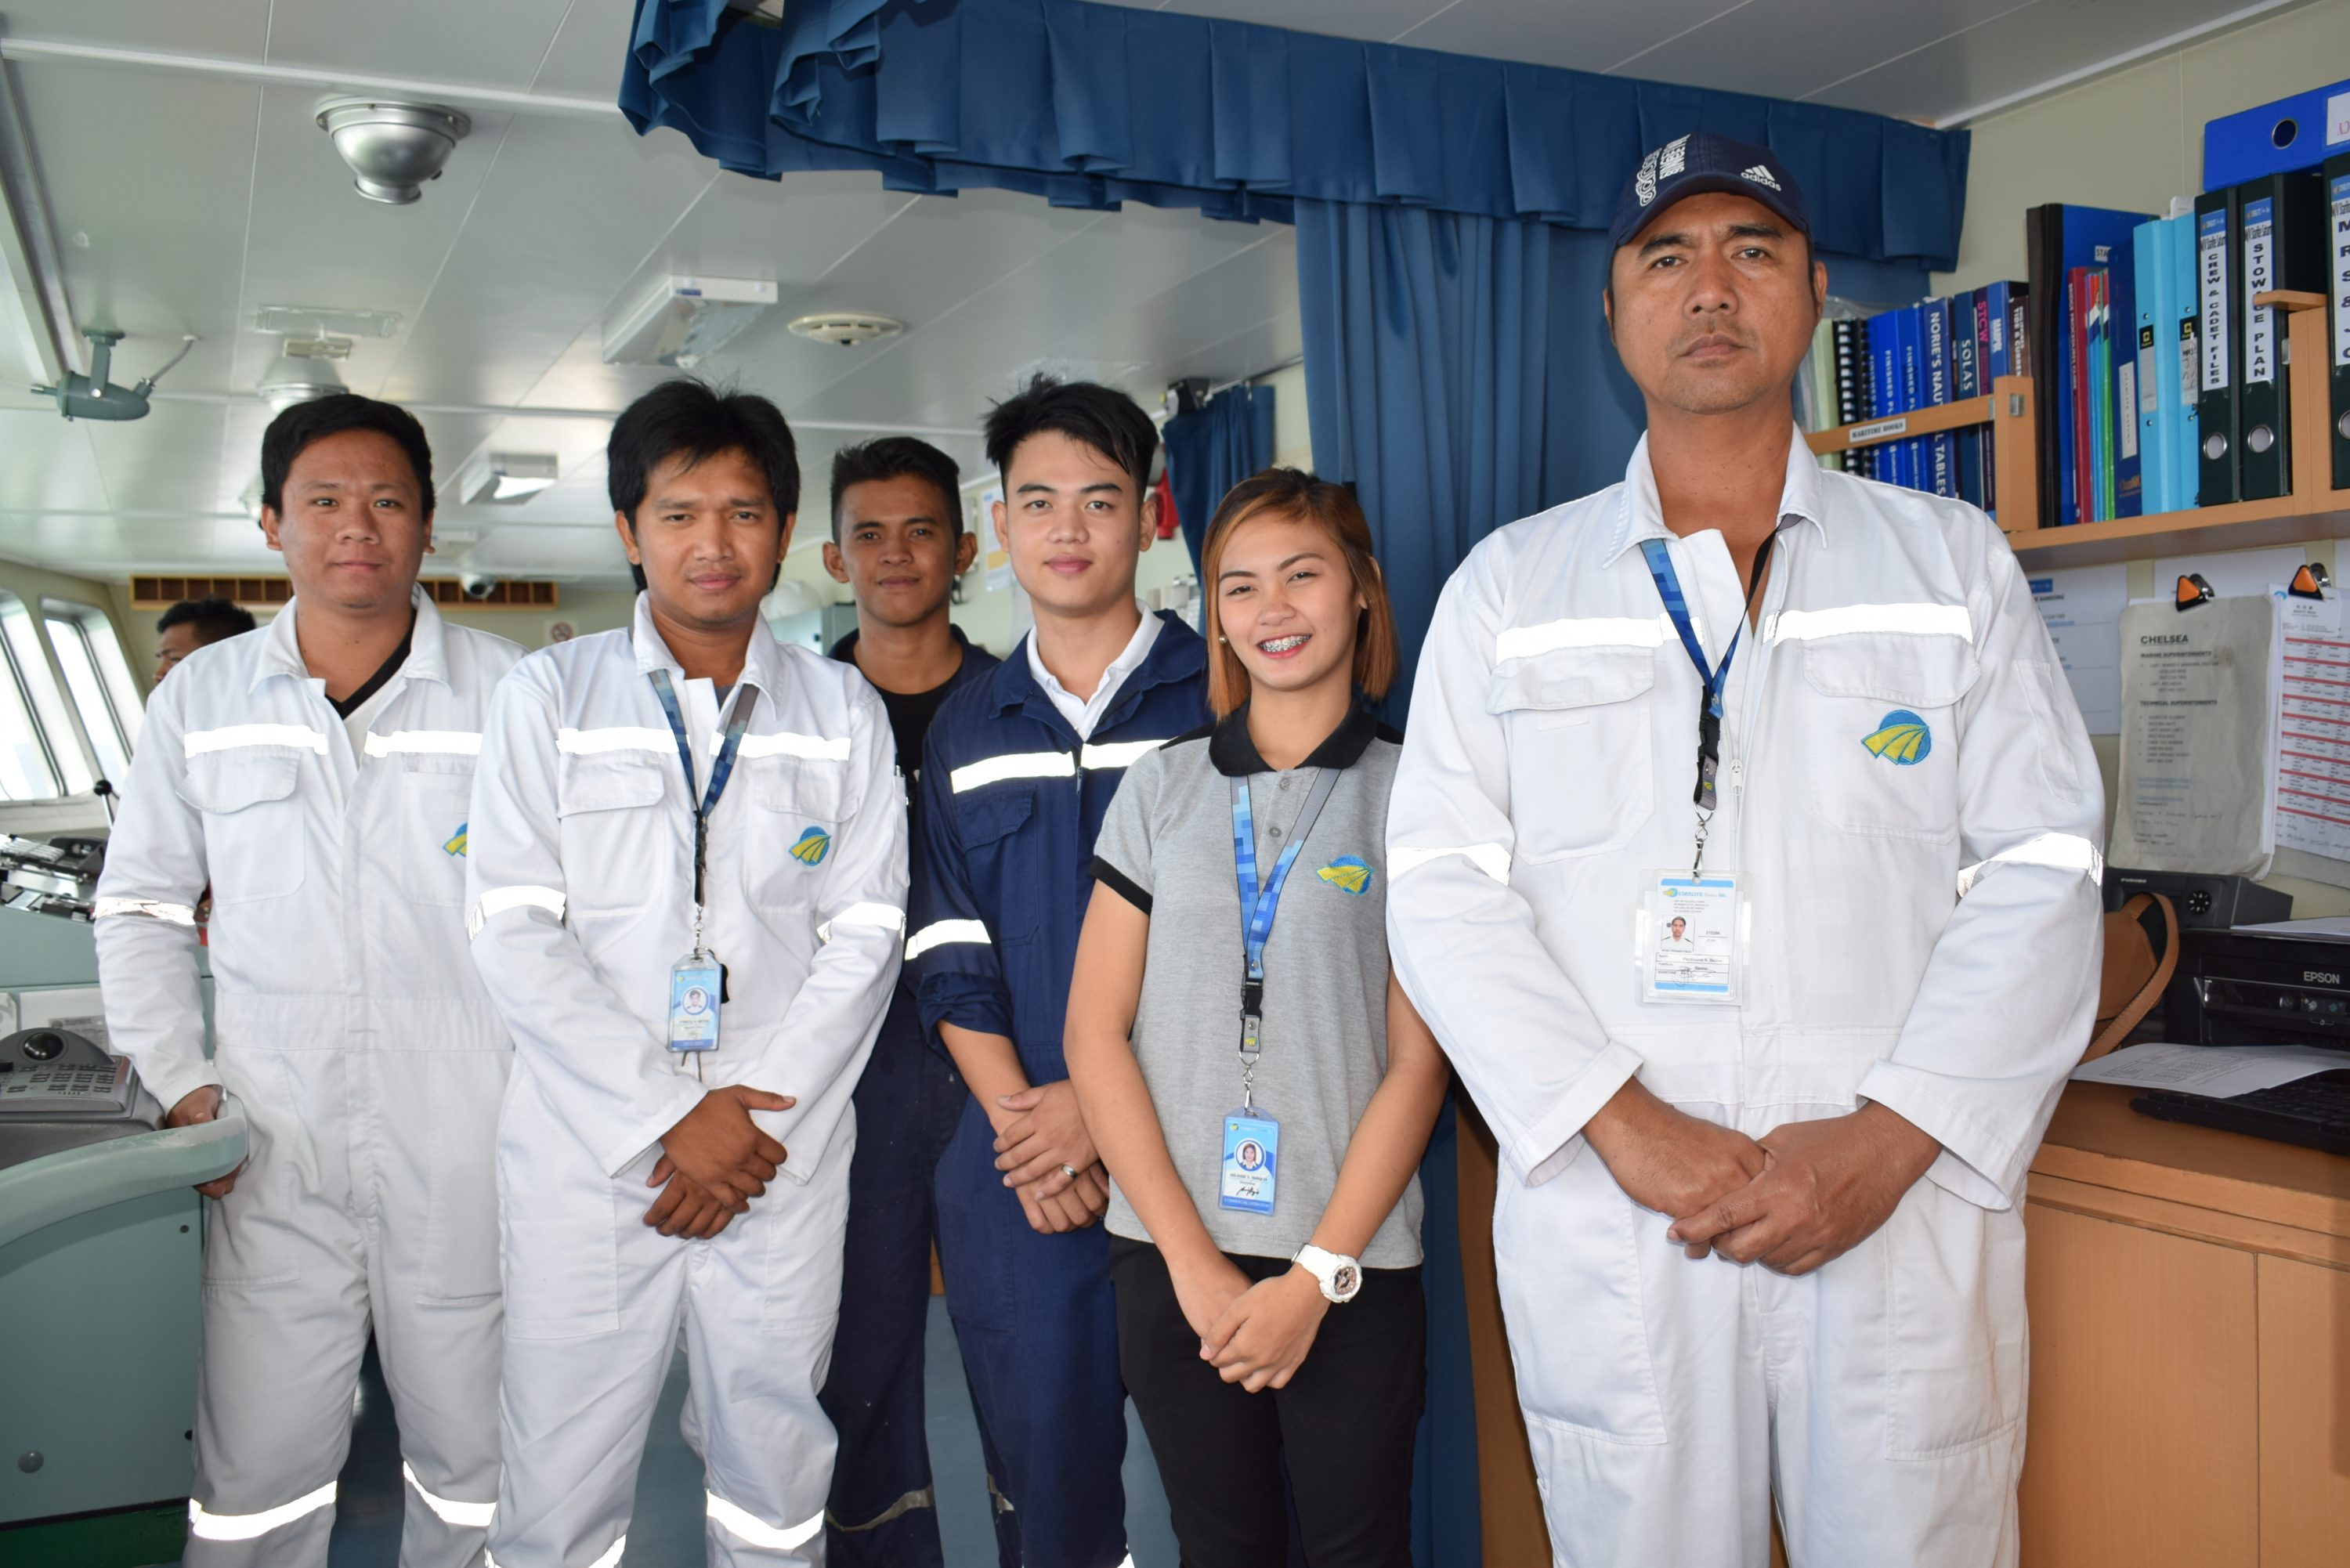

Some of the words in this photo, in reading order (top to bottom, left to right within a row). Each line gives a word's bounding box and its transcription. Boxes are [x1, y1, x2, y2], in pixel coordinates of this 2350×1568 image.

[1741, 171, 1781, 192] adidas
[2207, 254, 2221, 284] CREW
[2251, 244, 2266, 323] STOWE
[1931, 312, 1942, 368] NORIE'S
[1978, 301, 1988, 342] STCW
[2209, 302, 2219, 340] CADET
[1961, 339, 1973, 391] SOLAS
[2211, 346, 2220, 384] FILES
[2254, 333, 2265, 377] PLAN
[1883, 423, 1904, 432] BOOKS
[1935, 444, 1947, 495] TABLES
[2141, 634, 2189, 644] CHELSEA
[2303, 971, 2340, 985] EPSON
